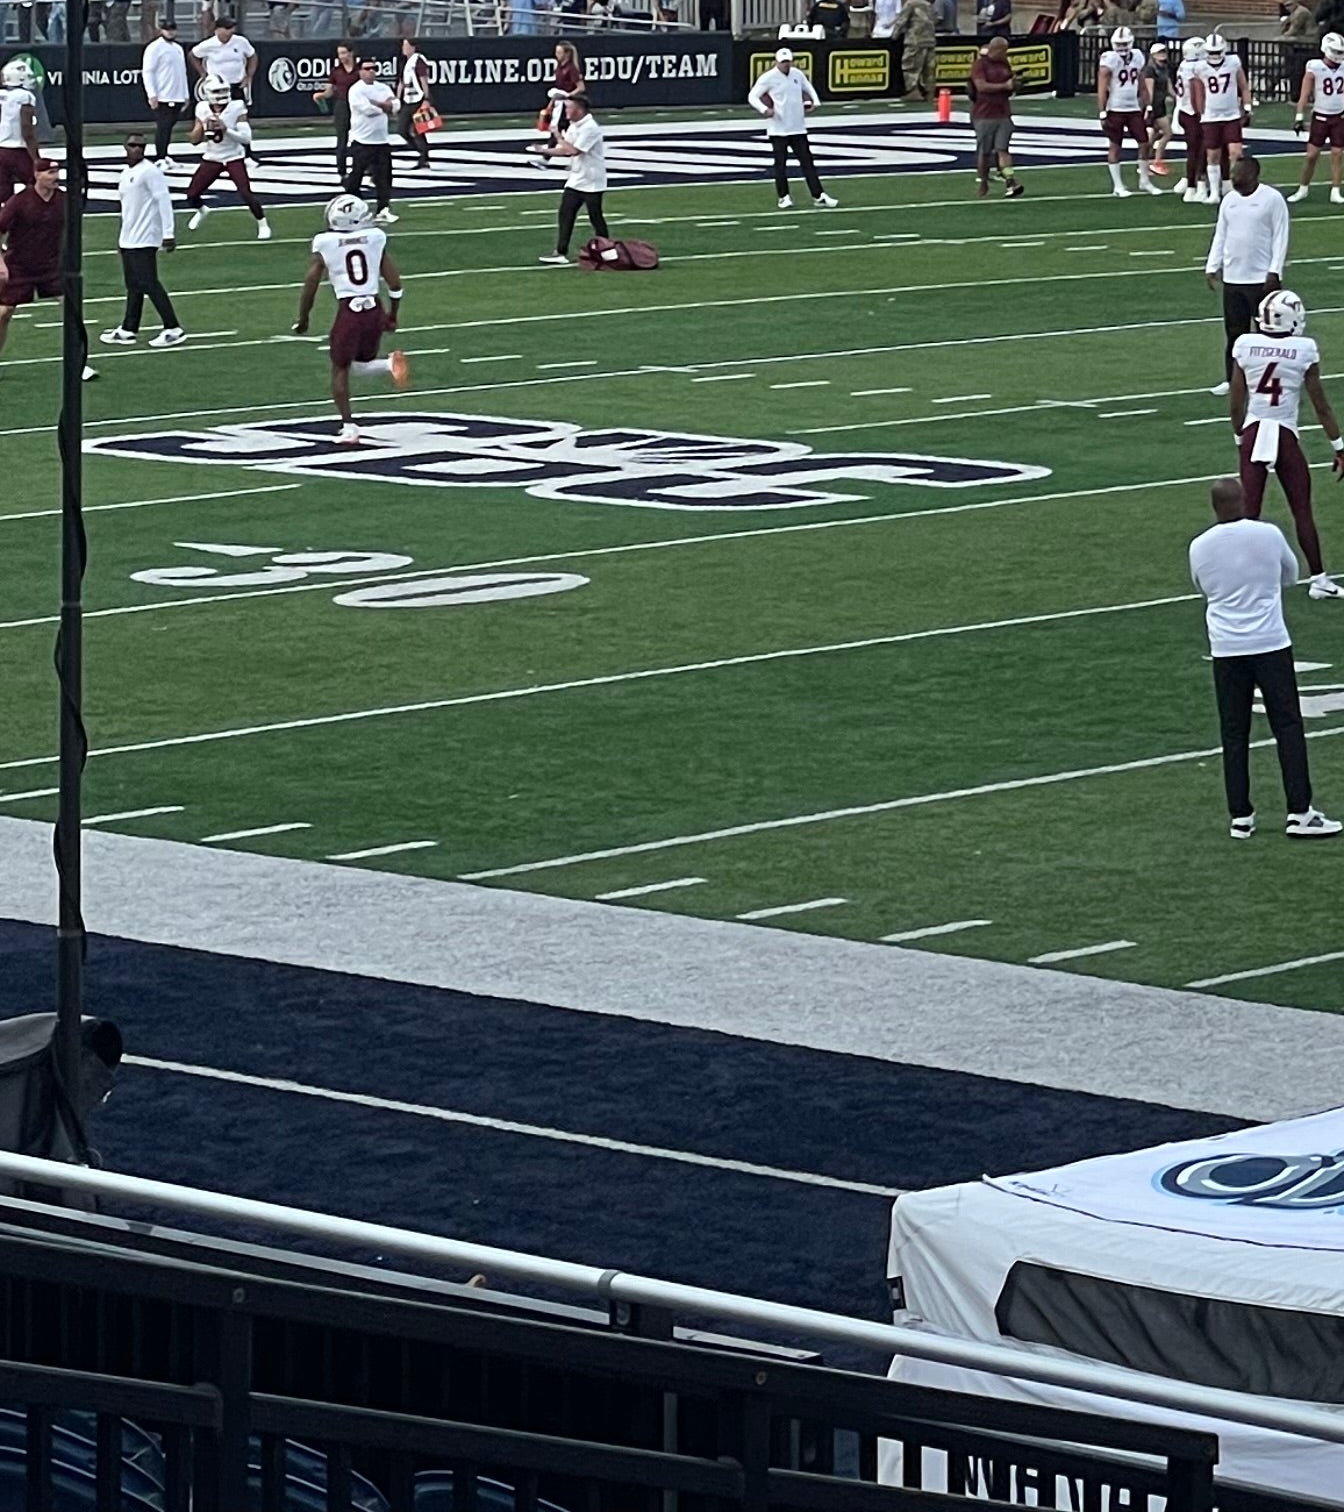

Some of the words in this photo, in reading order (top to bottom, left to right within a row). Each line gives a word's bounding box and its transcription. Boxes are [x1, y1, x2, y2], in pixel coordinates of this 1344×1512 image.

[48, 71, 109, 85] VIINIA
[1207, 74, 1231, 94] 87
[1323, 77, 1344, 96] 82
[346, 249, 368, 286] 0
[1256, 361, 1284, 407] 4
